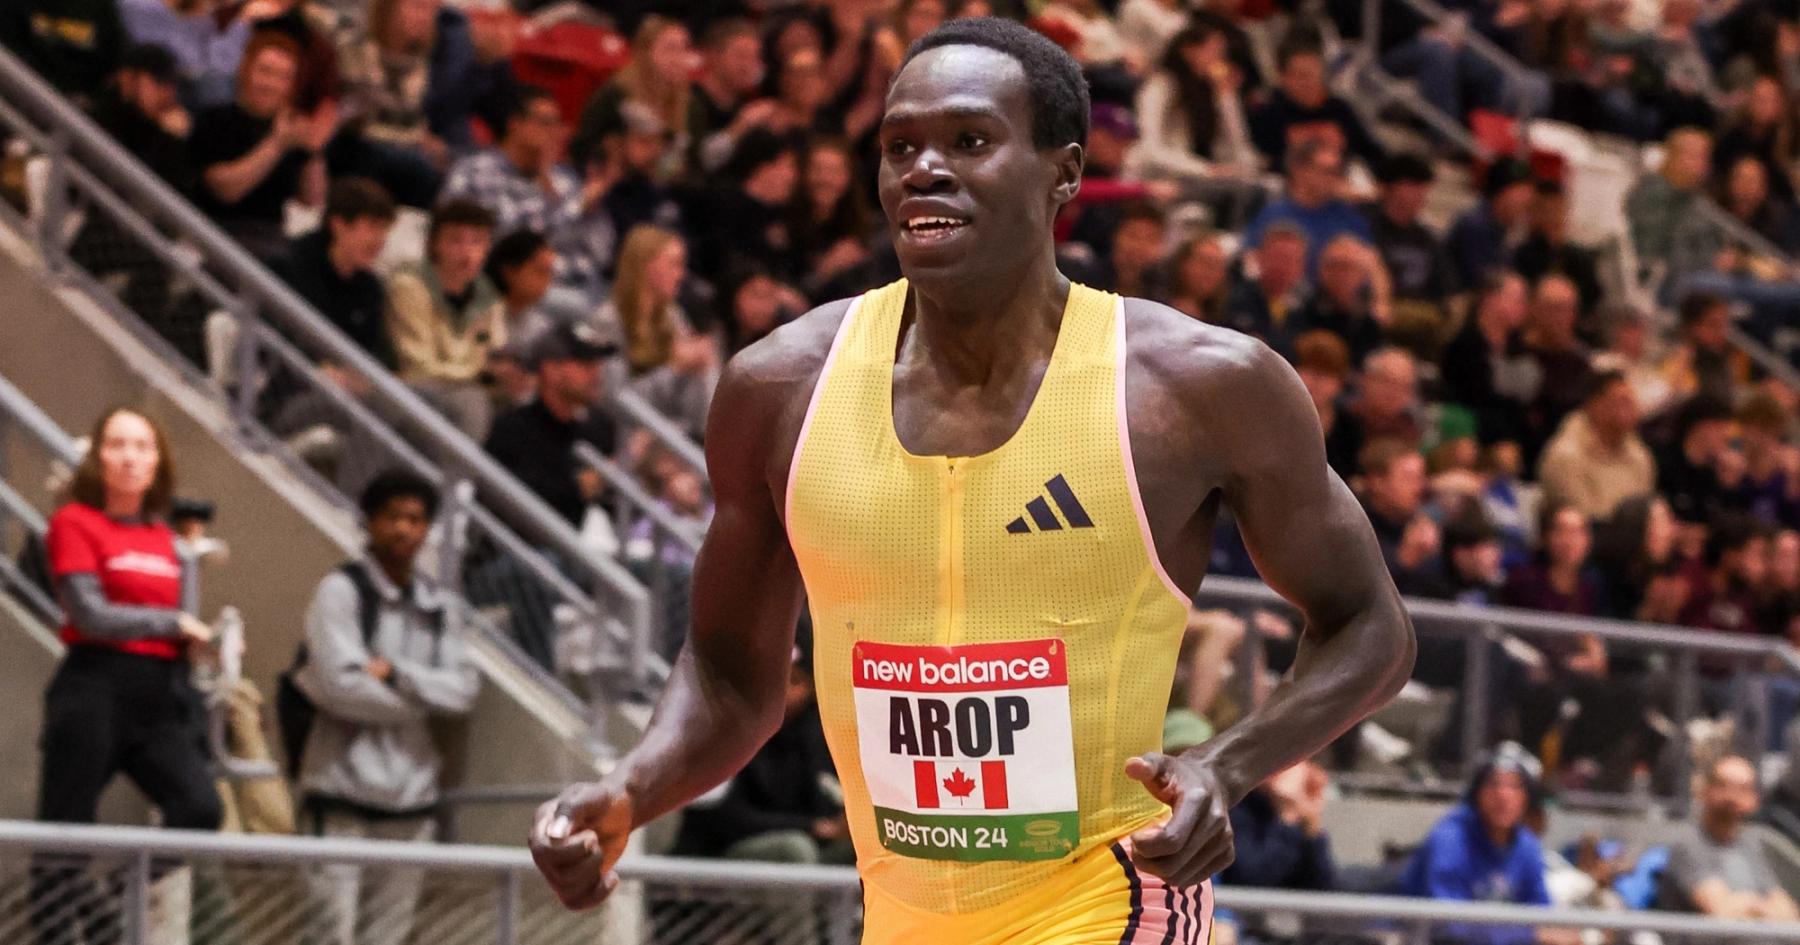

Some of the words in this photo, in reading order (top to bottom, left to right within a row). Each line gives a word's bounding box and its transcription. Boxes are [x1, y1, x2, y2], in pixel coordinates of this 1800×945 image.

[863, 658, 913, 683] new
[919, 656, 1051, 684] balance
[889, 695, 1030, 758] AROP
[884, 818, 968, 848] BOSTON
[975, 827, 1008, 848] 24
